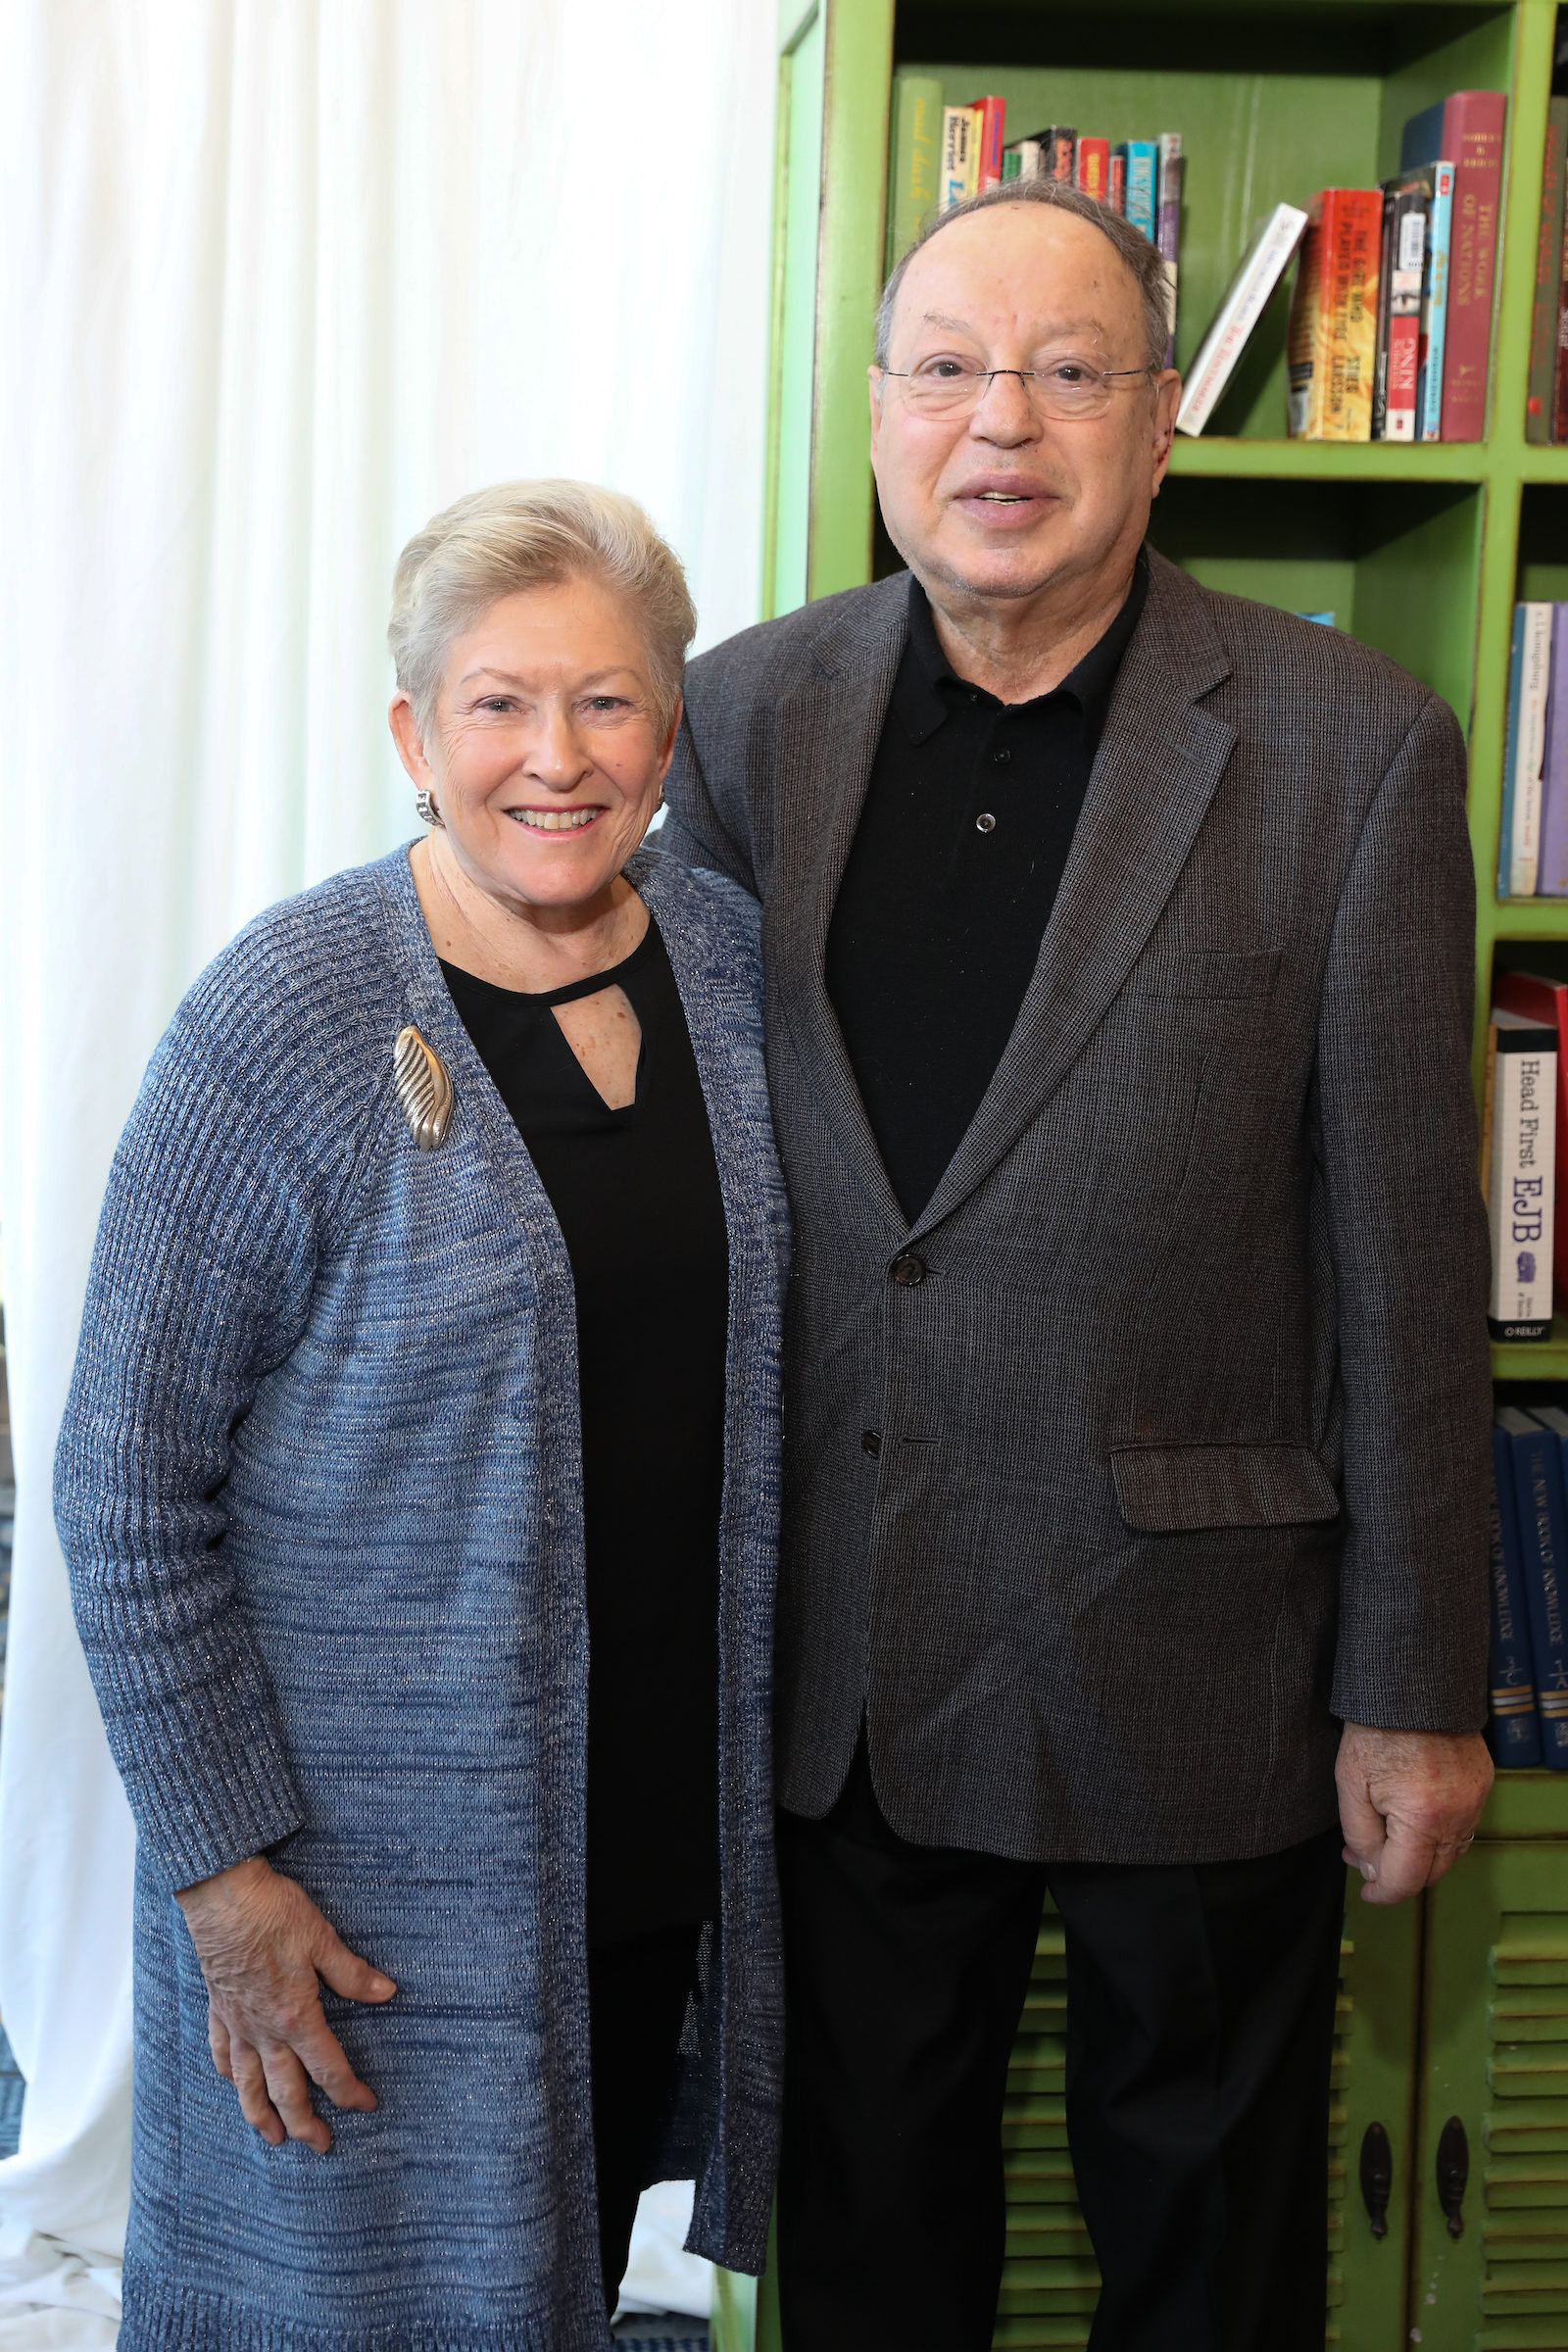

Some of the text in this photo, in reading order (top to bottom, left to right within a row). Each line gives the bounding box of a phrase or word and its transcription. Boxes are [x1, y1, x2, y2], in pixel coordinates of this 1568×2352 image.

[1399, 337, 1416, 389] KING
[1518, 1059, 1542, 1169] Head First
[1512, 1175, 1544, 1243] EJB
[1489, 1509, 1502, 1544] BOOK
[1491, 1547, 1504, 1561] OF
[1531, 1450, 1563, 1646] THE NEW BOOK OF KNOWLEDGE
[1494, 1565, 1513, 1642] KNOWLEDGE
